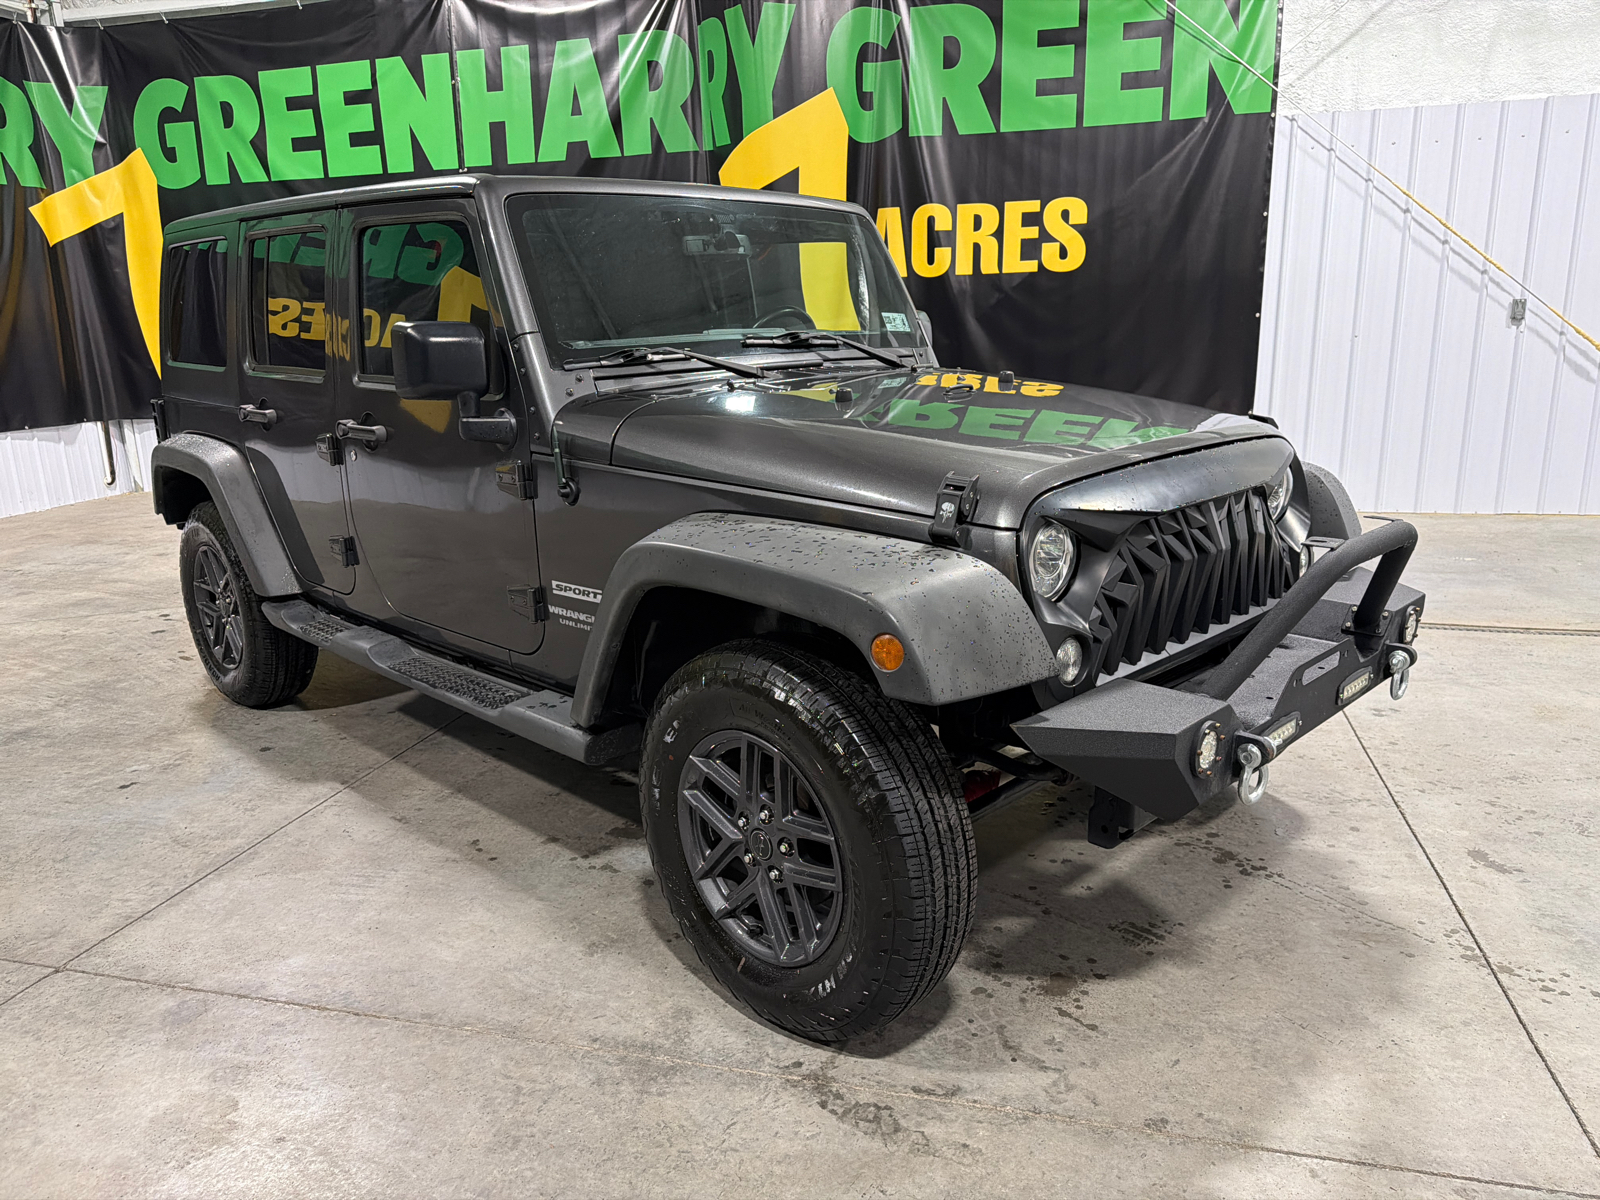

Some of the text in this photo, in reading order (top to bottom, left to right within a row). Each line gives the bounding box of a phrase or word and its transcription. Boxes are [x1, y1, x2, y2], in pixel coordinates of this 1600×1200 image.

[456, 0, 1277, 167] HARRY GREEN
[133, 54, 459, 190] GREEN
[555, 583, 602, 599] SPORT
[559, 618, 592, 631] UNLIMI
